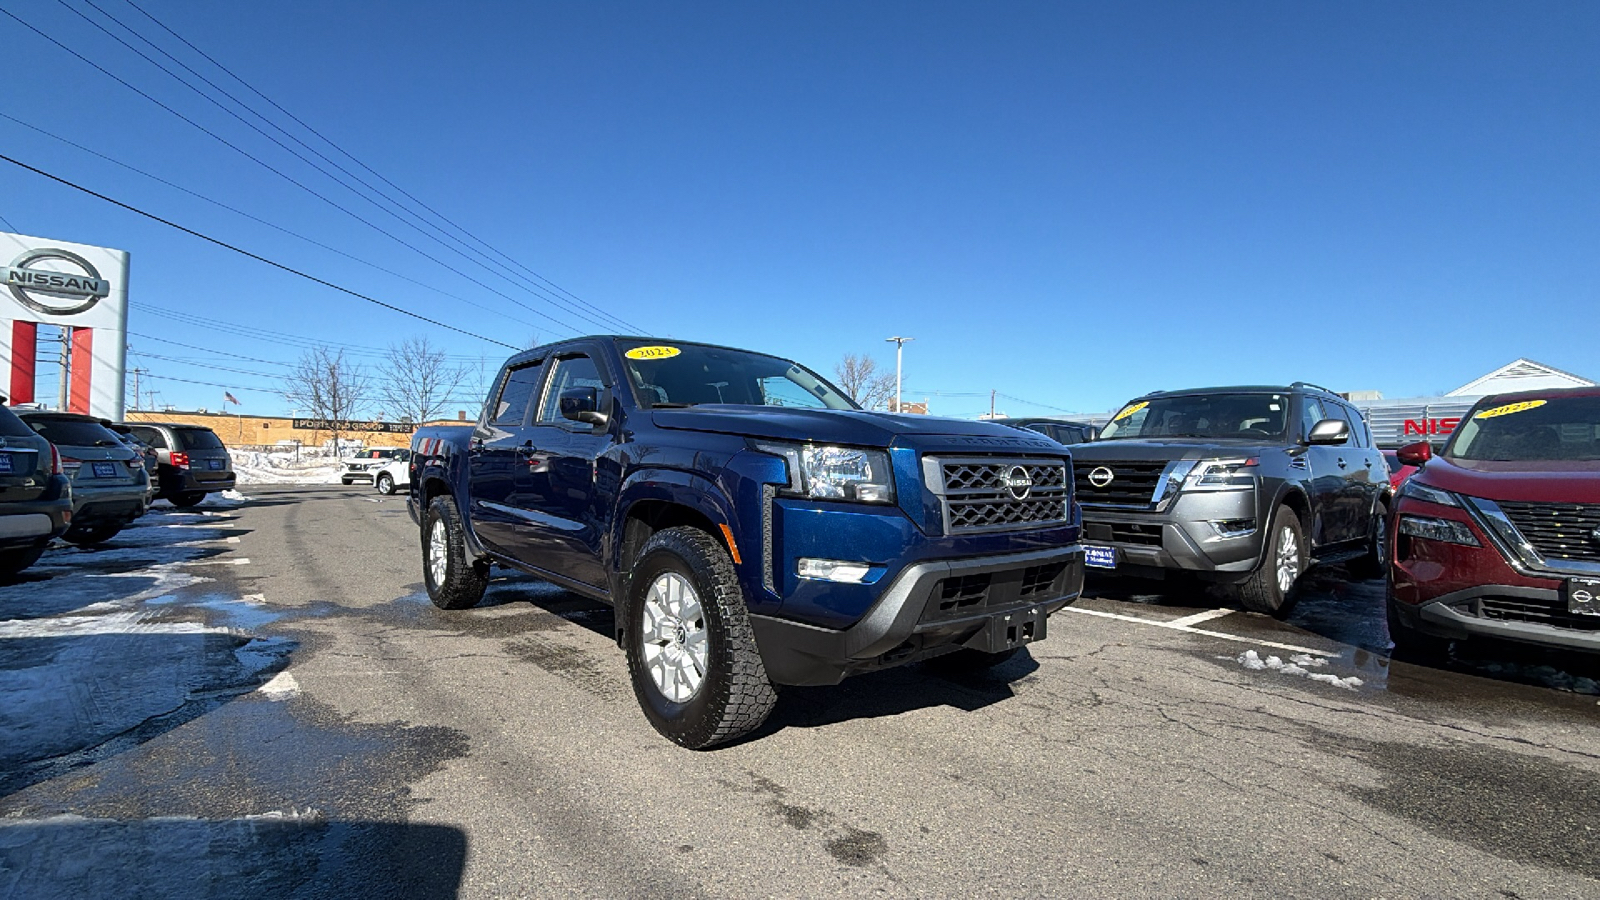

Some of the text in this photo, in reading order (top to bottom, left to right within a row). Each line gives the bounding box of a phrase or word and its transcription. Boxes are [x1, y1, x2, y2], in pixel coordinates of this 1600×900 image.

[9, 270, 99, 292] NISSAN
[636, 347, 672, 358] 2023
[1404, 418, 1461, 434] NIS
